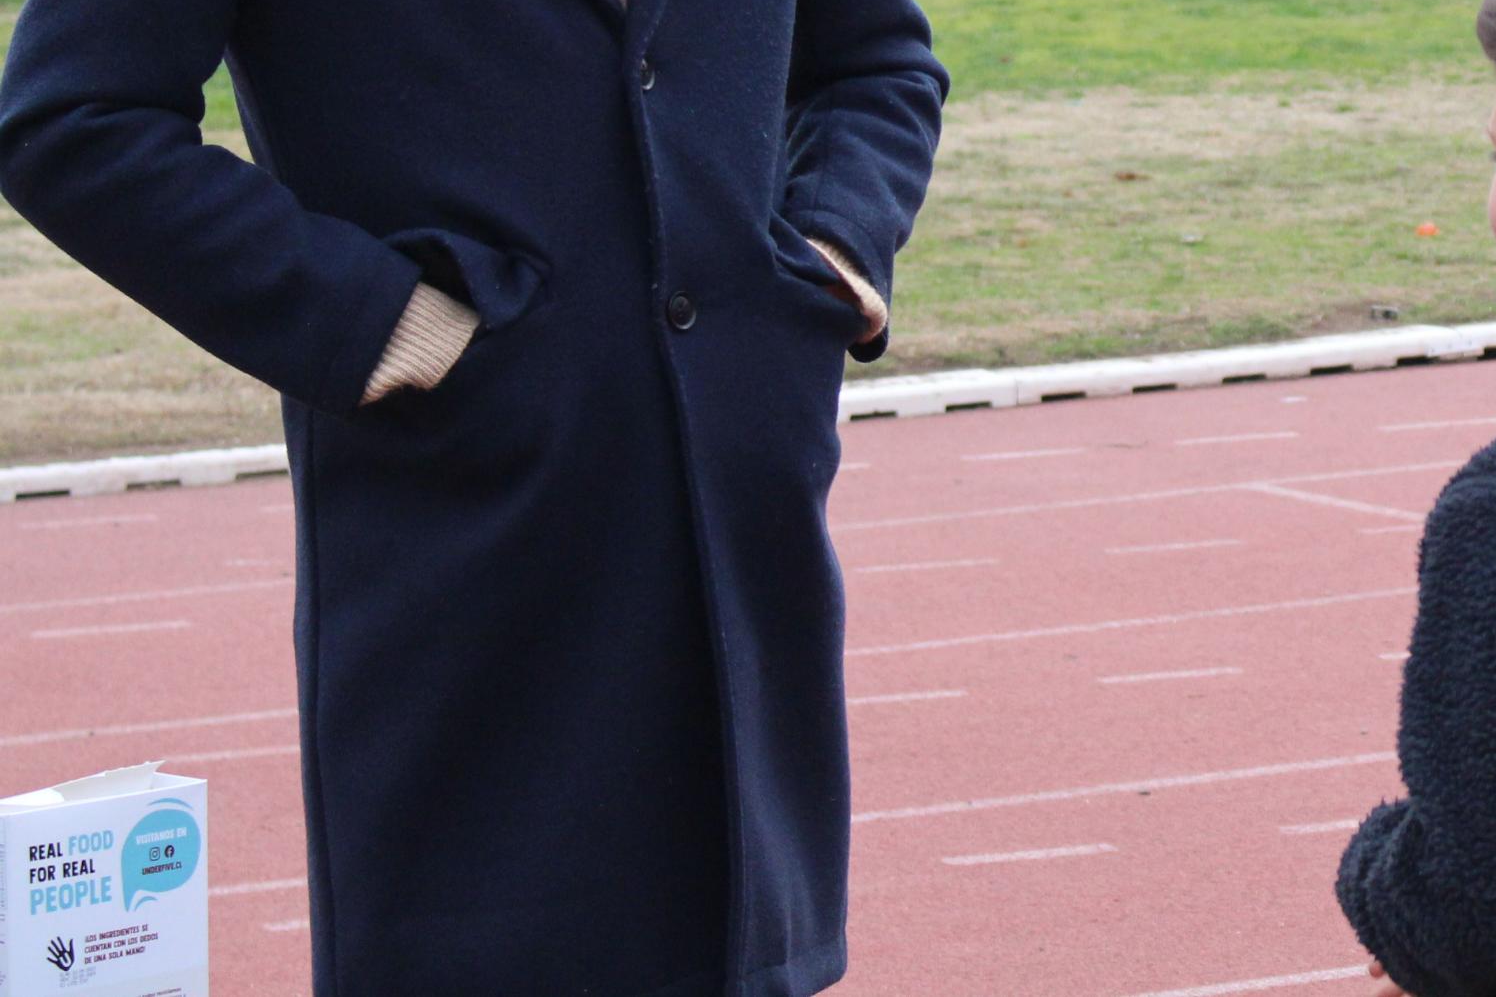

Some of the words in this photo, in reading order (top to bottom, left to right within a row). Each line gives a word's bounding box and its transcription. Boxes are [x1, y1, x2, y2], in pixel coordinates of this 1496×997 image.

[29, 842, 63, 862] REAL
[68, 830, 114, 857] FOOD
[29, 865, 56, 884] FOR
[63, 858, 95, 878] REAL
[30, 876, 112, 915] PEOPLE
[84, 956, 92, 965] DE
[94, 954, 107, 963] UNA
[109, 950, 123, 960] SOLA
[85, 942, 112, 954] CUENTAN
[114, 939, 126, 948] CON
